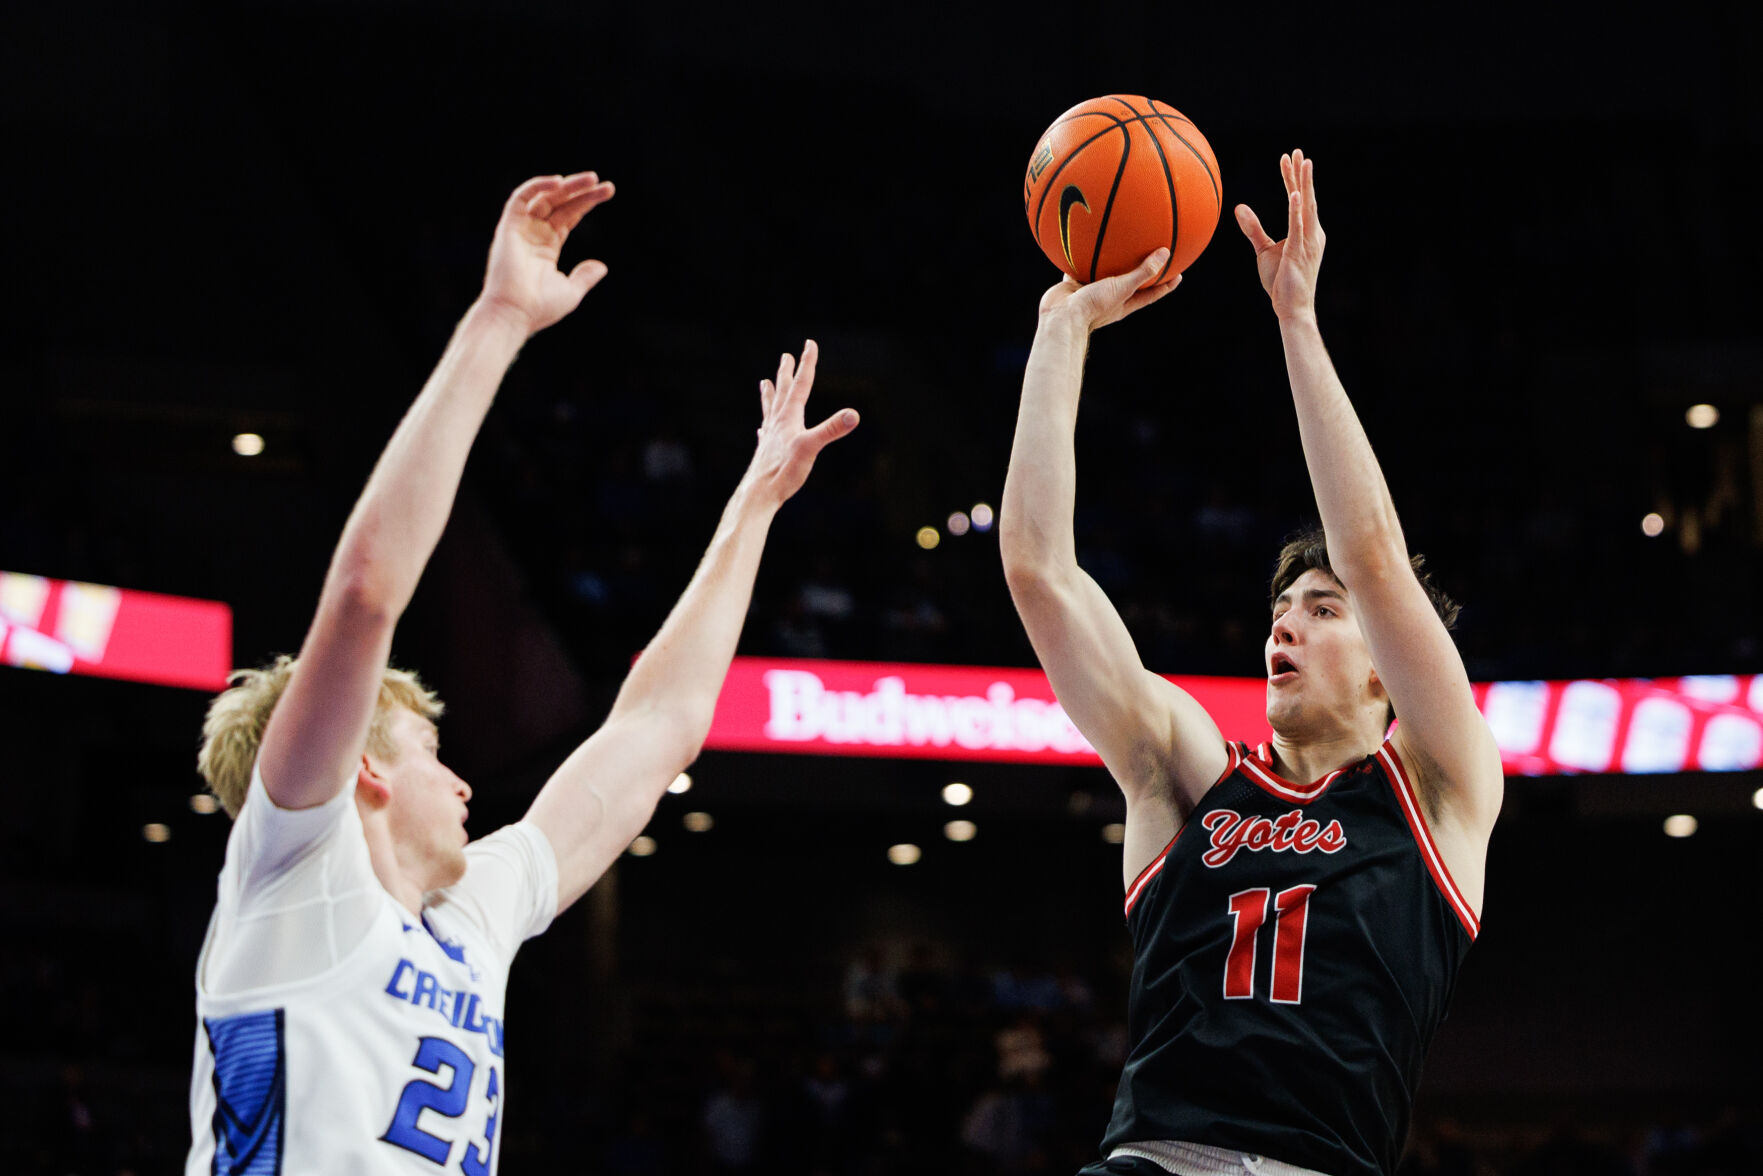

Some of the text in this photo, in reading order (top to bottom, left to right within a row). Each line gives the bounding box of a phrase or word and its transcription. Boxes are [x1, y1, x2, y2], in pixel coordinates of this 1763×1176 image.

[764, 670, 1097, 753] Budweise
[1202, 809, 1347, 868] Yotes
[1223, 884, 1317, 1004] 11
[377, 1036, 499, 1176] 23
